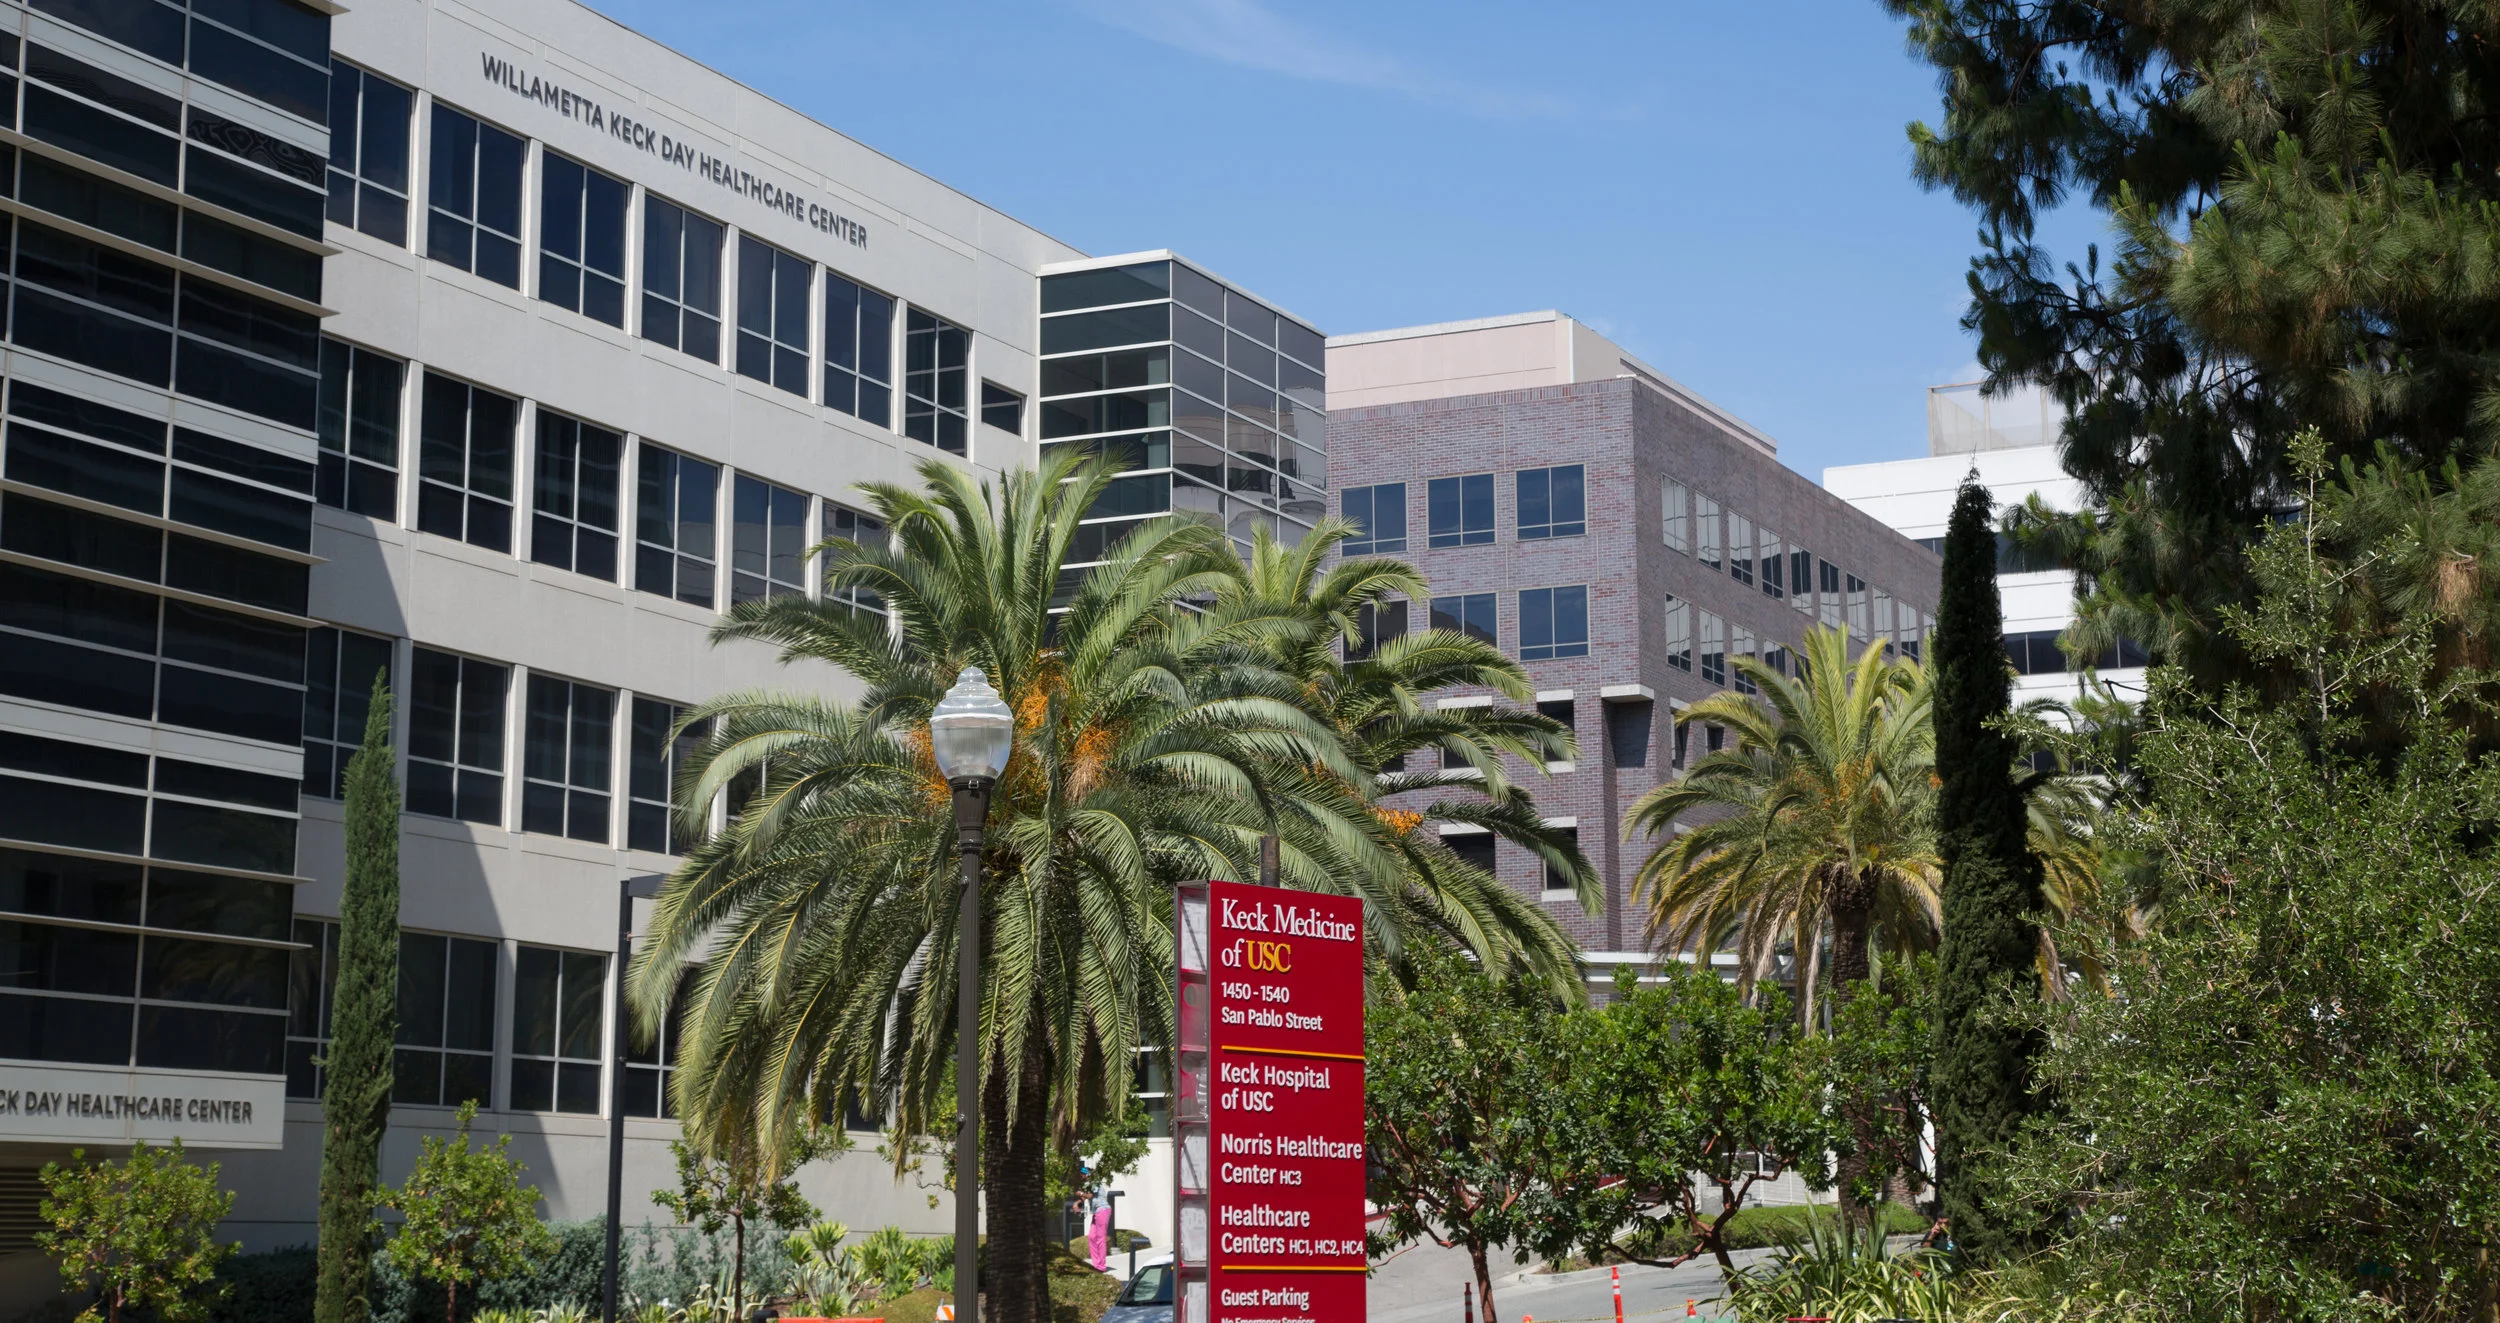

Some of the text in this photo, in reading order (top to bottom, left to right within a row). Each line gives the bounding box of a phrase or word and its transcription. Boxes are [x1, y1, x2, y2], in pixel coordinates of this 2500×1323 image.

[482, 51, 867, 249] WILLAMETTA KECK DAY HEALTHCARE CENTER
[1222, 898, 1356, 942] Keck Medicine
[1222, 938, 1291, 973] of USC
[1222, 1007, 1323, 1031] San Pablo Street
[1222, 1062, 1330, 1093] Keck Hospital
[25, 1091, 62, 1116] DAY
[67, 1092, 183, 1121] HEALTHCARE
[187, 1099, 253, 1123] CENTER
[1222, 1088, 1274, 1112] of USC
[1222, 1133, 1362, 1160] Norris Healthcare
[1222, 1162, 1302, 1186] Center HC3
[1221, 1204, 1310, 1228] Healthcare
[1222, 1232, 1364, 1257] Centers HC1, HC2, HC4
[1221, 1287, 1309, 1311] Guest Parking
